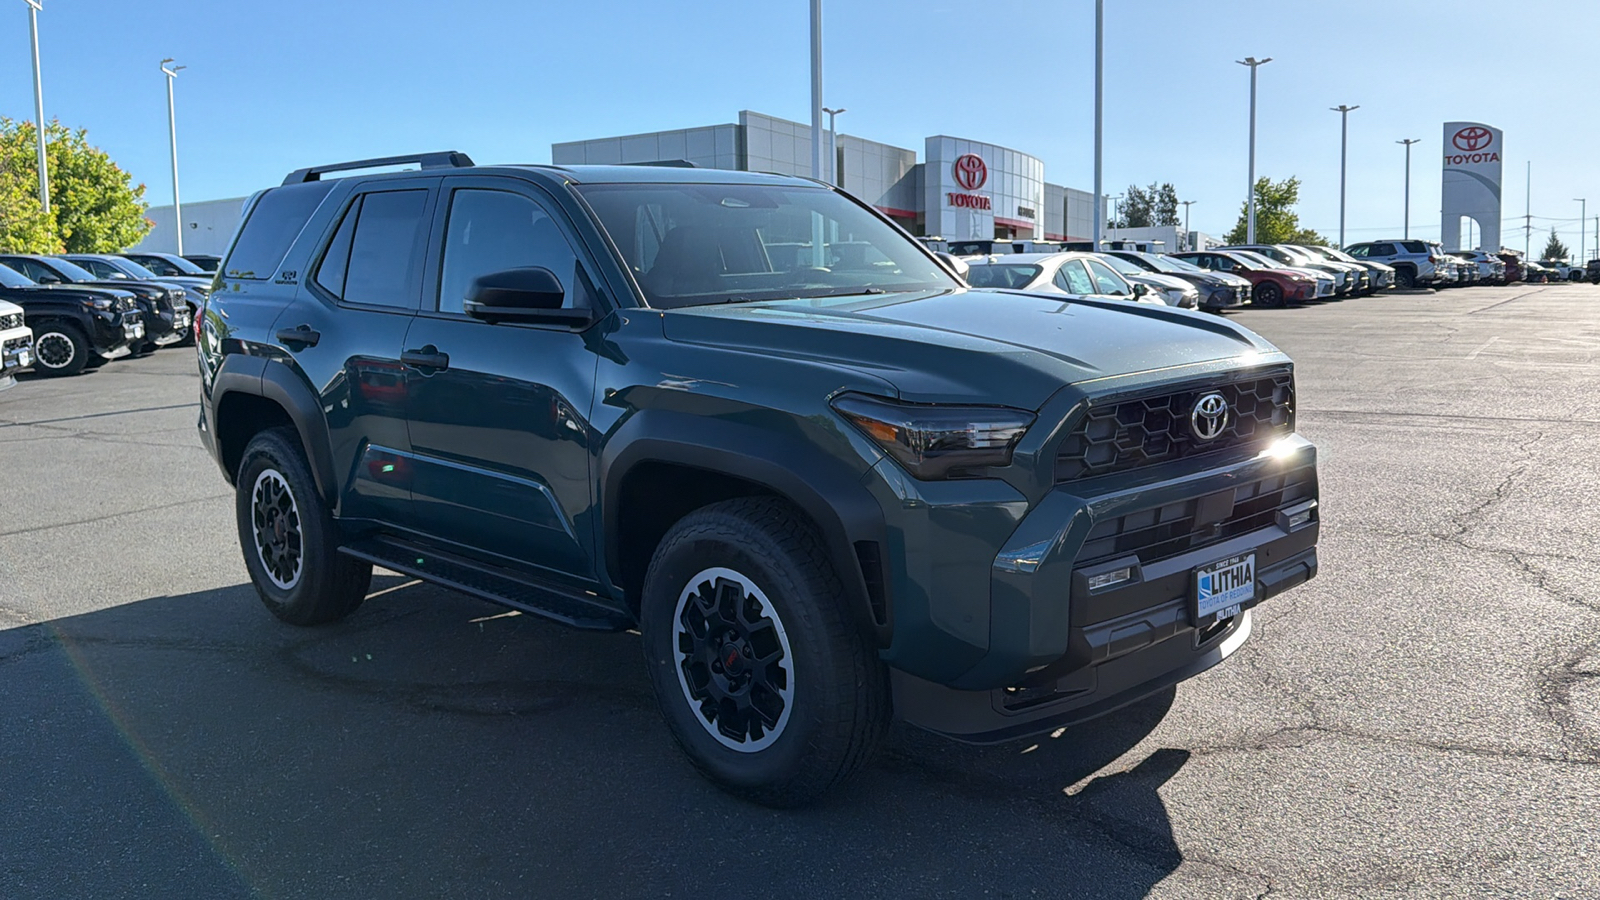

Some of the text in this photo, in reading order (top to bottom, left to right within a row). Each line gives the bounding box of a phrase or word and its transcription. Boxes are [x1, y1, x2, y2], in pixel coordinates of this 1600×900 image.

[1445, 152, 1500, 165] TOYOTA
[948, 192, 991, 210] TOYOTA
[1216, 559, 1229, 570] SINCE
[1211, 563, 1252, 595] LITHIA
[1199, 584, 1253, 610] TOYOTA OF REDDING
[1222, 603, 1242, 620] LITHIA
